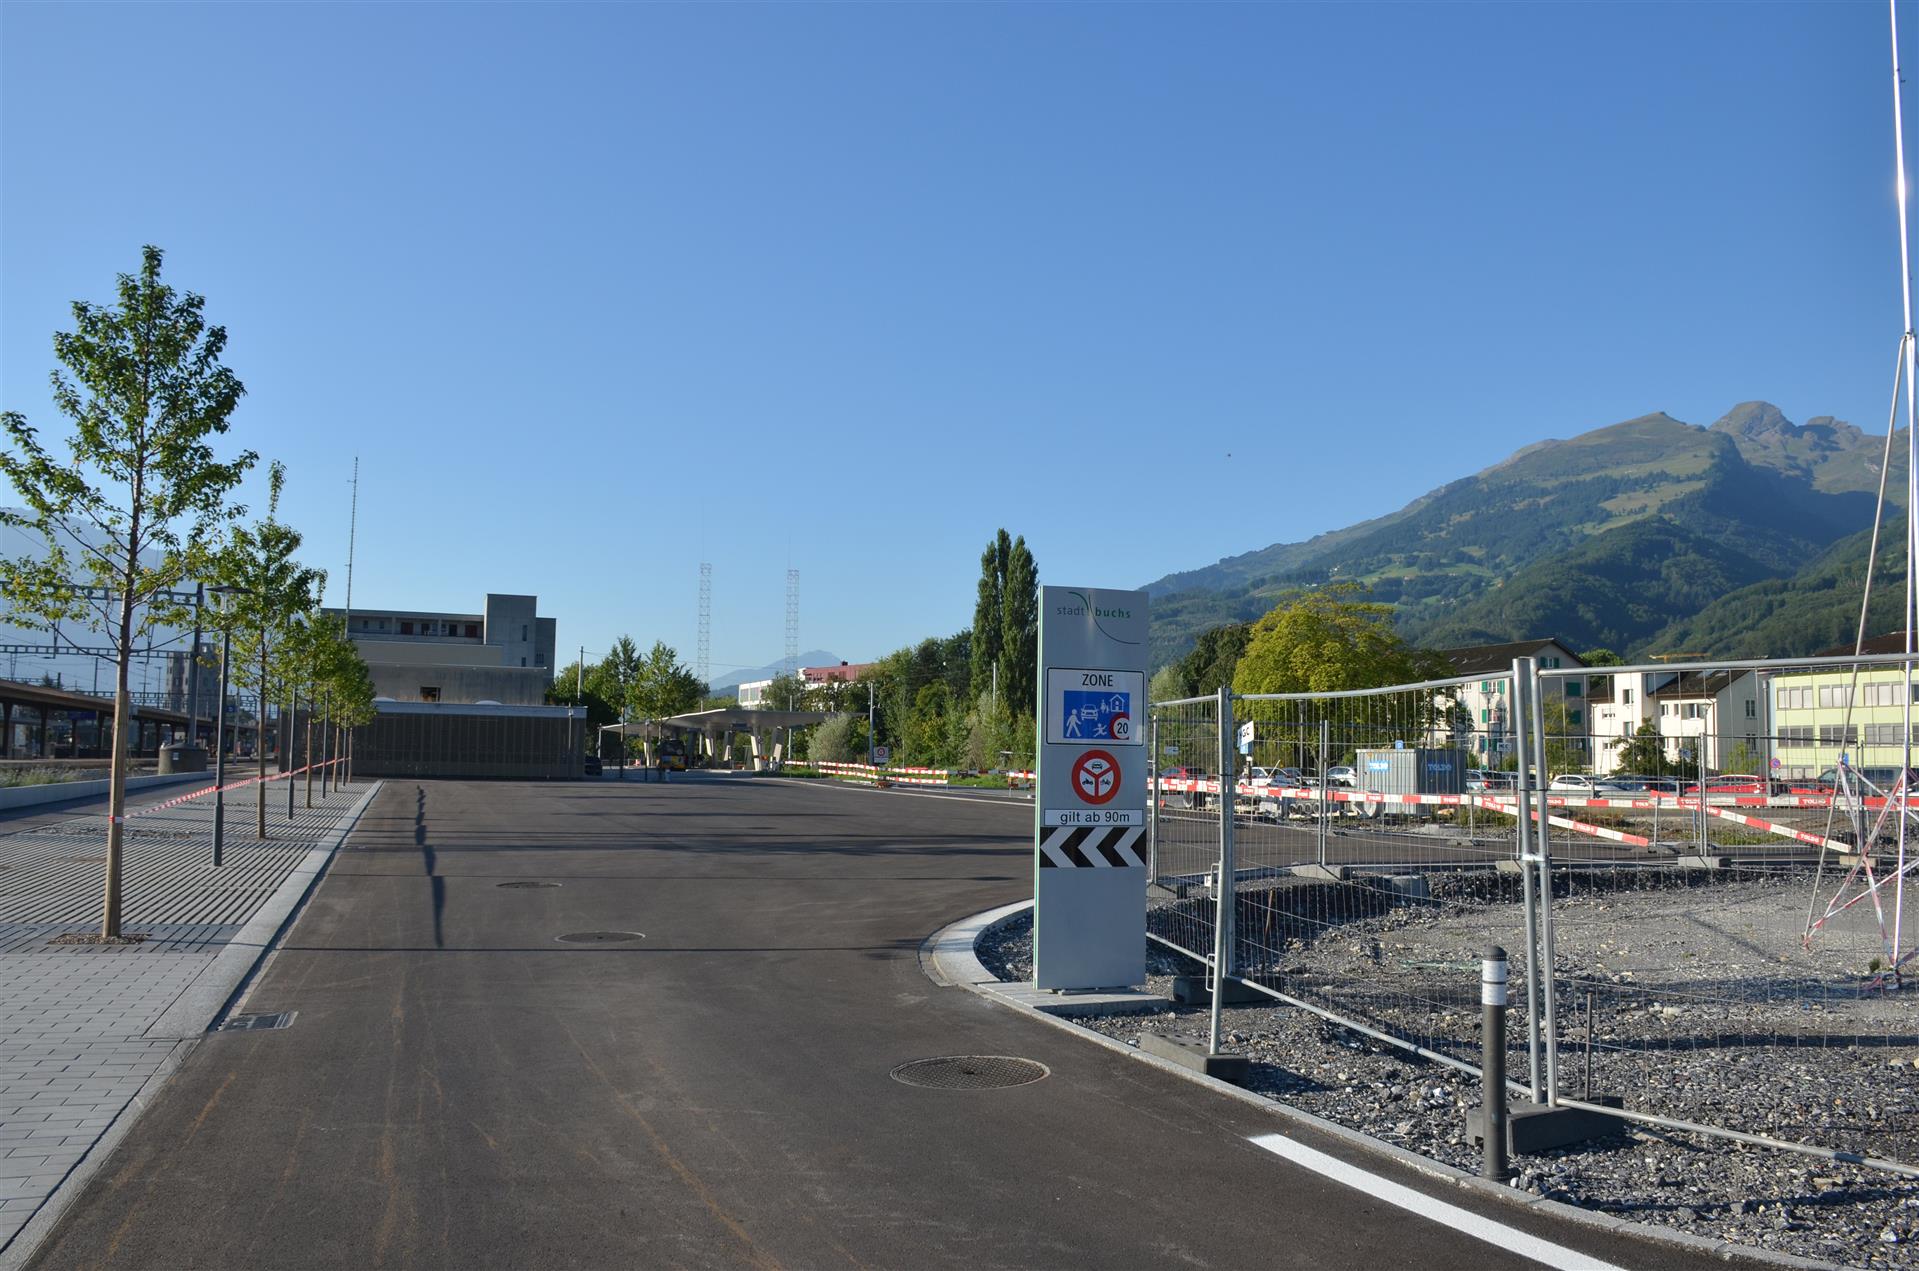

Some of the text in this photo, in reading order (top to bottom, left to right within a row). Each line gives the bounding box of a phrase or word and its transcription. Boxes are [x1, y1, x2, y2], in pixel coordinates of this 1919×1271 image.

[1057, 606, 1131, 618] stadt buchs
[1082, 673, 1113, 687] ZONE
[1117, 722, 1129, 734] 20
[1060, 811, 1130, 825] gilt ab 90m
